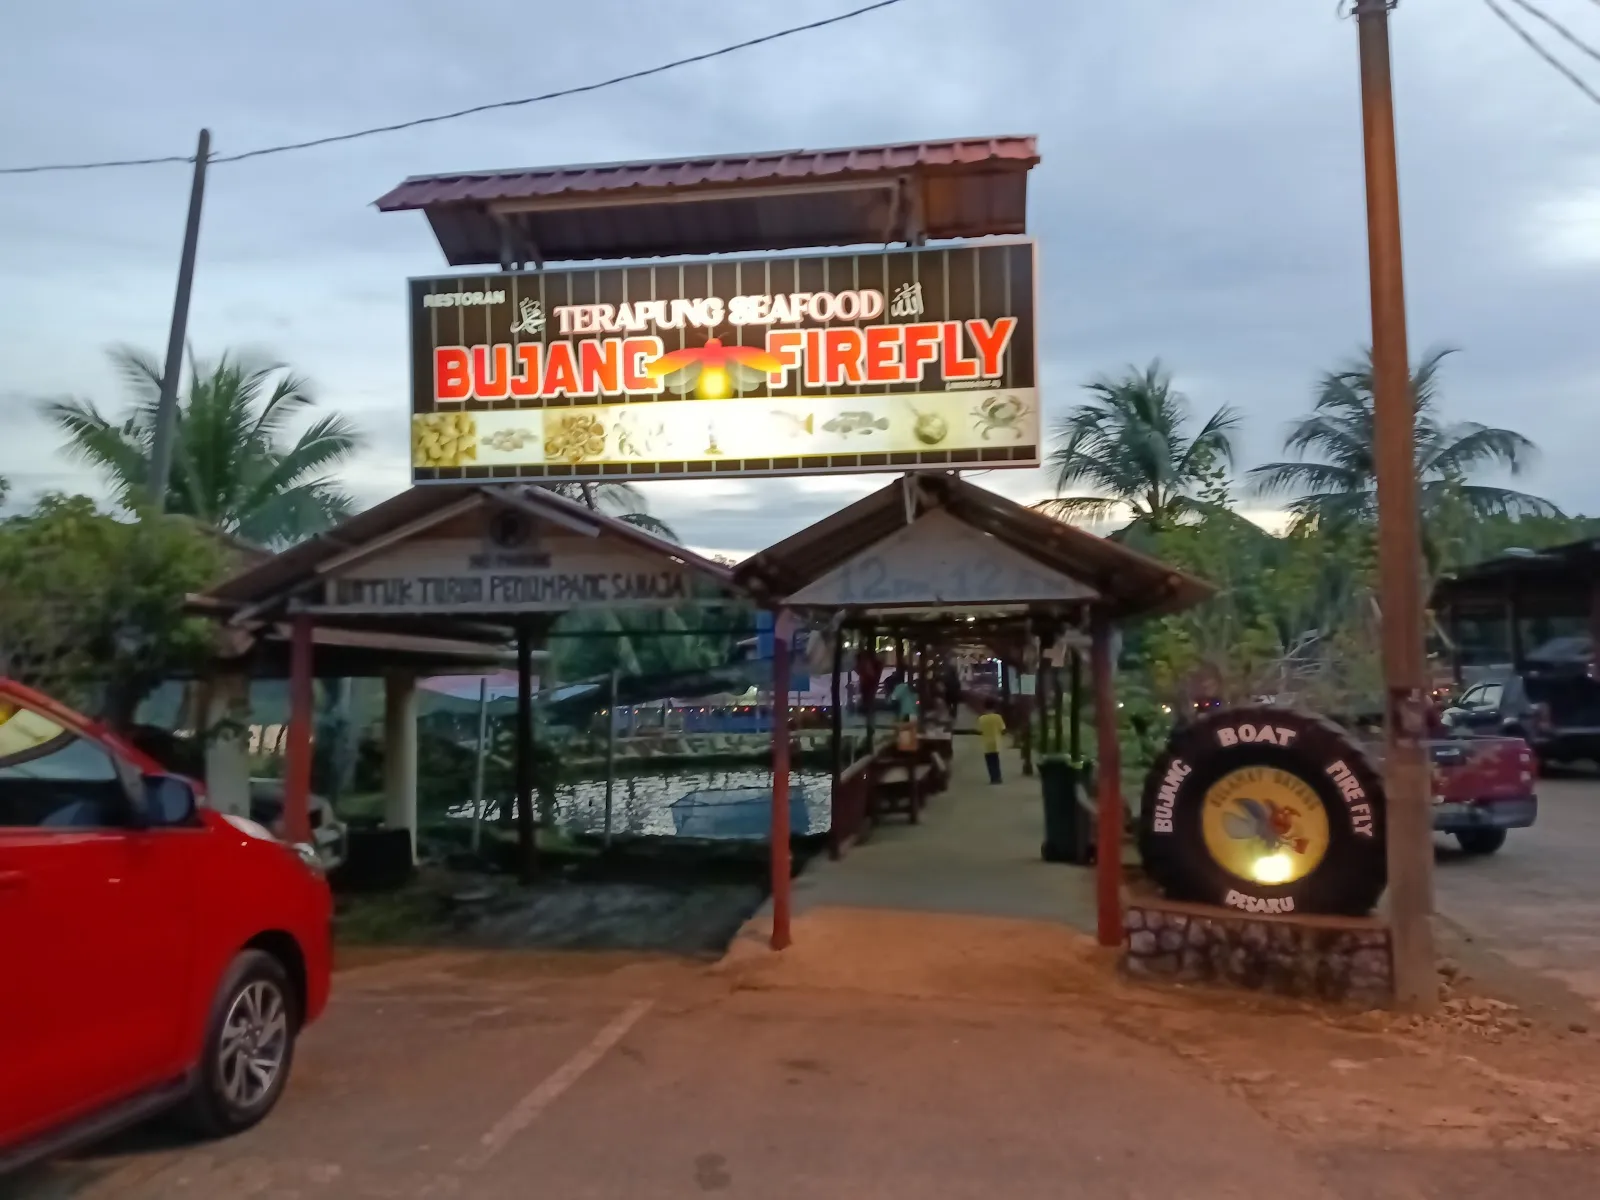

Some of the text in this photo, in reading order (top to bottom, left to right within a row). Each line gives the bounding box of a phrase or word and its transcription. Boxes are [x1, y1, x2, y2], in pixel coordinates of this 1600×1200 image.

[423, 289, 505, 308] RESTORAN
[553, 289, 883, 336] TERAPUNG SEAFOOD
[434, 316, 1018, 402] BUJANG FIREFLY
[1217, 723, 1297, 748] BOAT
[1153, 758, 1193, 834] BUJANG
